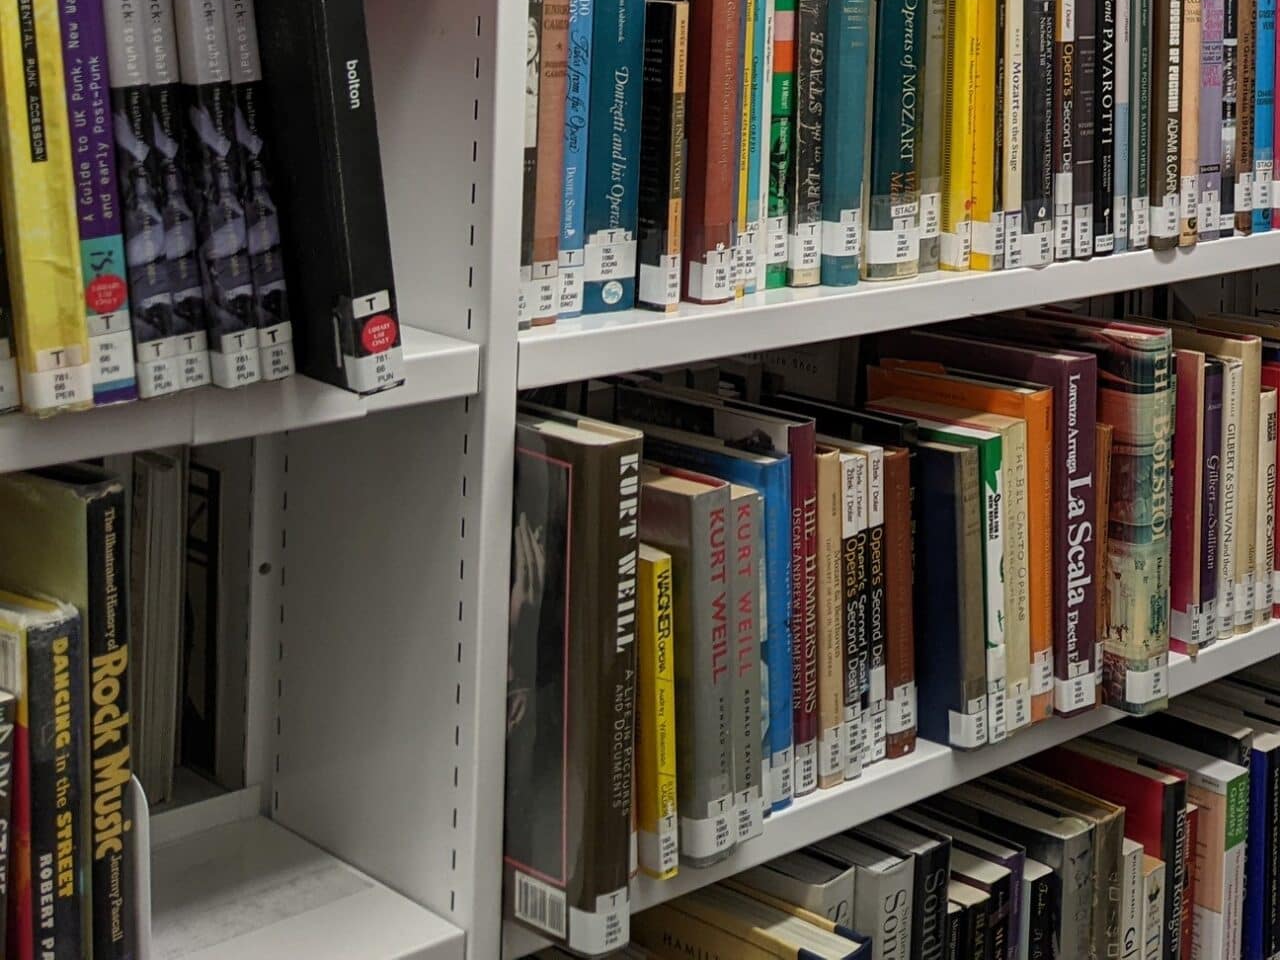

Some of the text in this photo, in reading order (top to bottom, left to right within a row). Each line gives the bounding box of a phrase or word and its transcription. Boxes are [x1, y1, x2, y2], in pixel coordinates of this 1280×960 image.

[67, 22, 80, 49] New
[900, 51, 915, 68] of
[25, 58, 38, 89] PUNK
[346, 59, 361, 110] bolton
[809, 31, 825, 117] STAGE
[1011, 61, 1022, 112] Mozart
[1101, 28, 1115, 145] PAVAROTTI
[31, 92, 46, 163] ACCESSORY
[74, 108, 88, 129] UK
[78, 135, 89, 154] to
[608, 65, 630, 182] Donizetti and his
[899, 73, 918, 165] MOZART
[1063, 101, 1073, 148] Second
[1166, 118, 1179, 154] ADAMI
[80, 161, 92, 206] Guide
[98, 143, 111, 187] early
[102, 192, 114, 220] and
[1067, 372, 1081, 427] Lorenzo
[1067, 472, 1093, 520] La
[1204, 454, 1221, 501] Gilbert
[1223, 423, 1236, 542] GILBERT SULLIVAN
[616, 453, 639, 654] KURT WEILL
[1066, 521, 1093, 608] Scala
[709, 508, 728, 686] KURT WEILL
[737, 504, 753, 679] KURT WEILL
[791, 612, 803, 710] HAMMERSTEIN
[803, 554, 818, 713] HAMMERSTEINS
[91, 643, 131, 751] Rock
[53, 637, 74, 898] DANCING in the STREET
[612, 684, 626, 809] AND DOCUMENTS
[91, 743, 133, 861] Music
[39, 853, 53, 929] ROBERT
